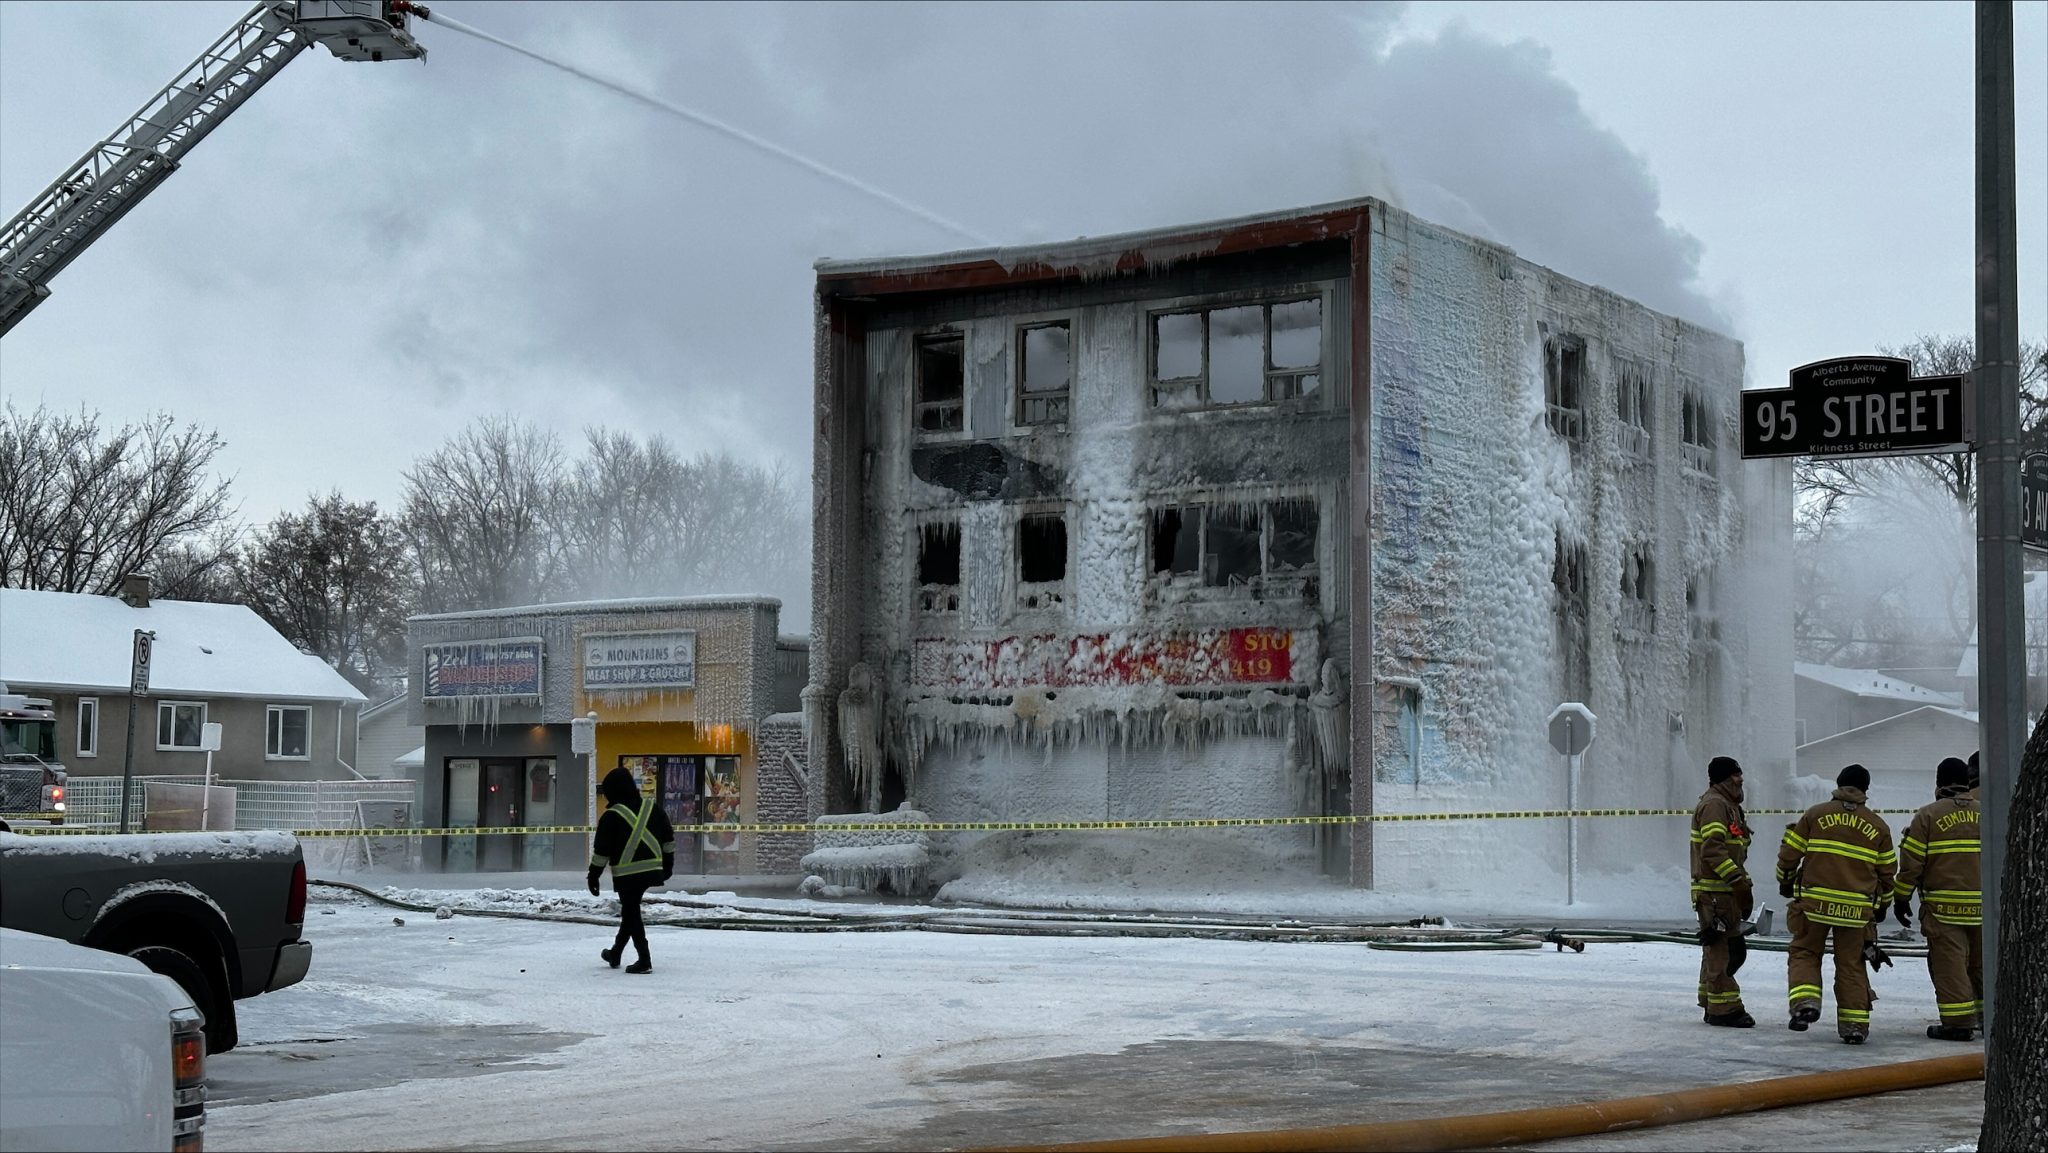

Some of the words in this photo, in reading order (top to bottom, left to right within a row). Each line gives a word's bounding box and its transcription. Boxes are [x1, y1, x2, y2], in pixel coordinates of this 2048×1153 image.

[1812, 365, 1849, 378] Alberta
[1852, 363, 1887, 373] Avenue
[1823, 376, 1876, 387] Community
[1757, 400, 1797, 442] 95
[1823, 388, 1949, 438] STREET
[1809, 444, 1855, 453] Kirkness
[1858, 441, 1890, 450] Street
[2035, 489, 2048, 531] AV
[607, 648, 669, 661] MOUNTAINS
[586, 668, 610, 681] MEAT
[612, 668, 636, 680] SHOP
[640, 668, 647, 680] &
[649, 666, 690, 679] GROCERY
[1818, 813, 1879, 840] EDMONTON
[1815, 901, 1825, 914] J.
[1827, 902, 1863, 919] BARON
